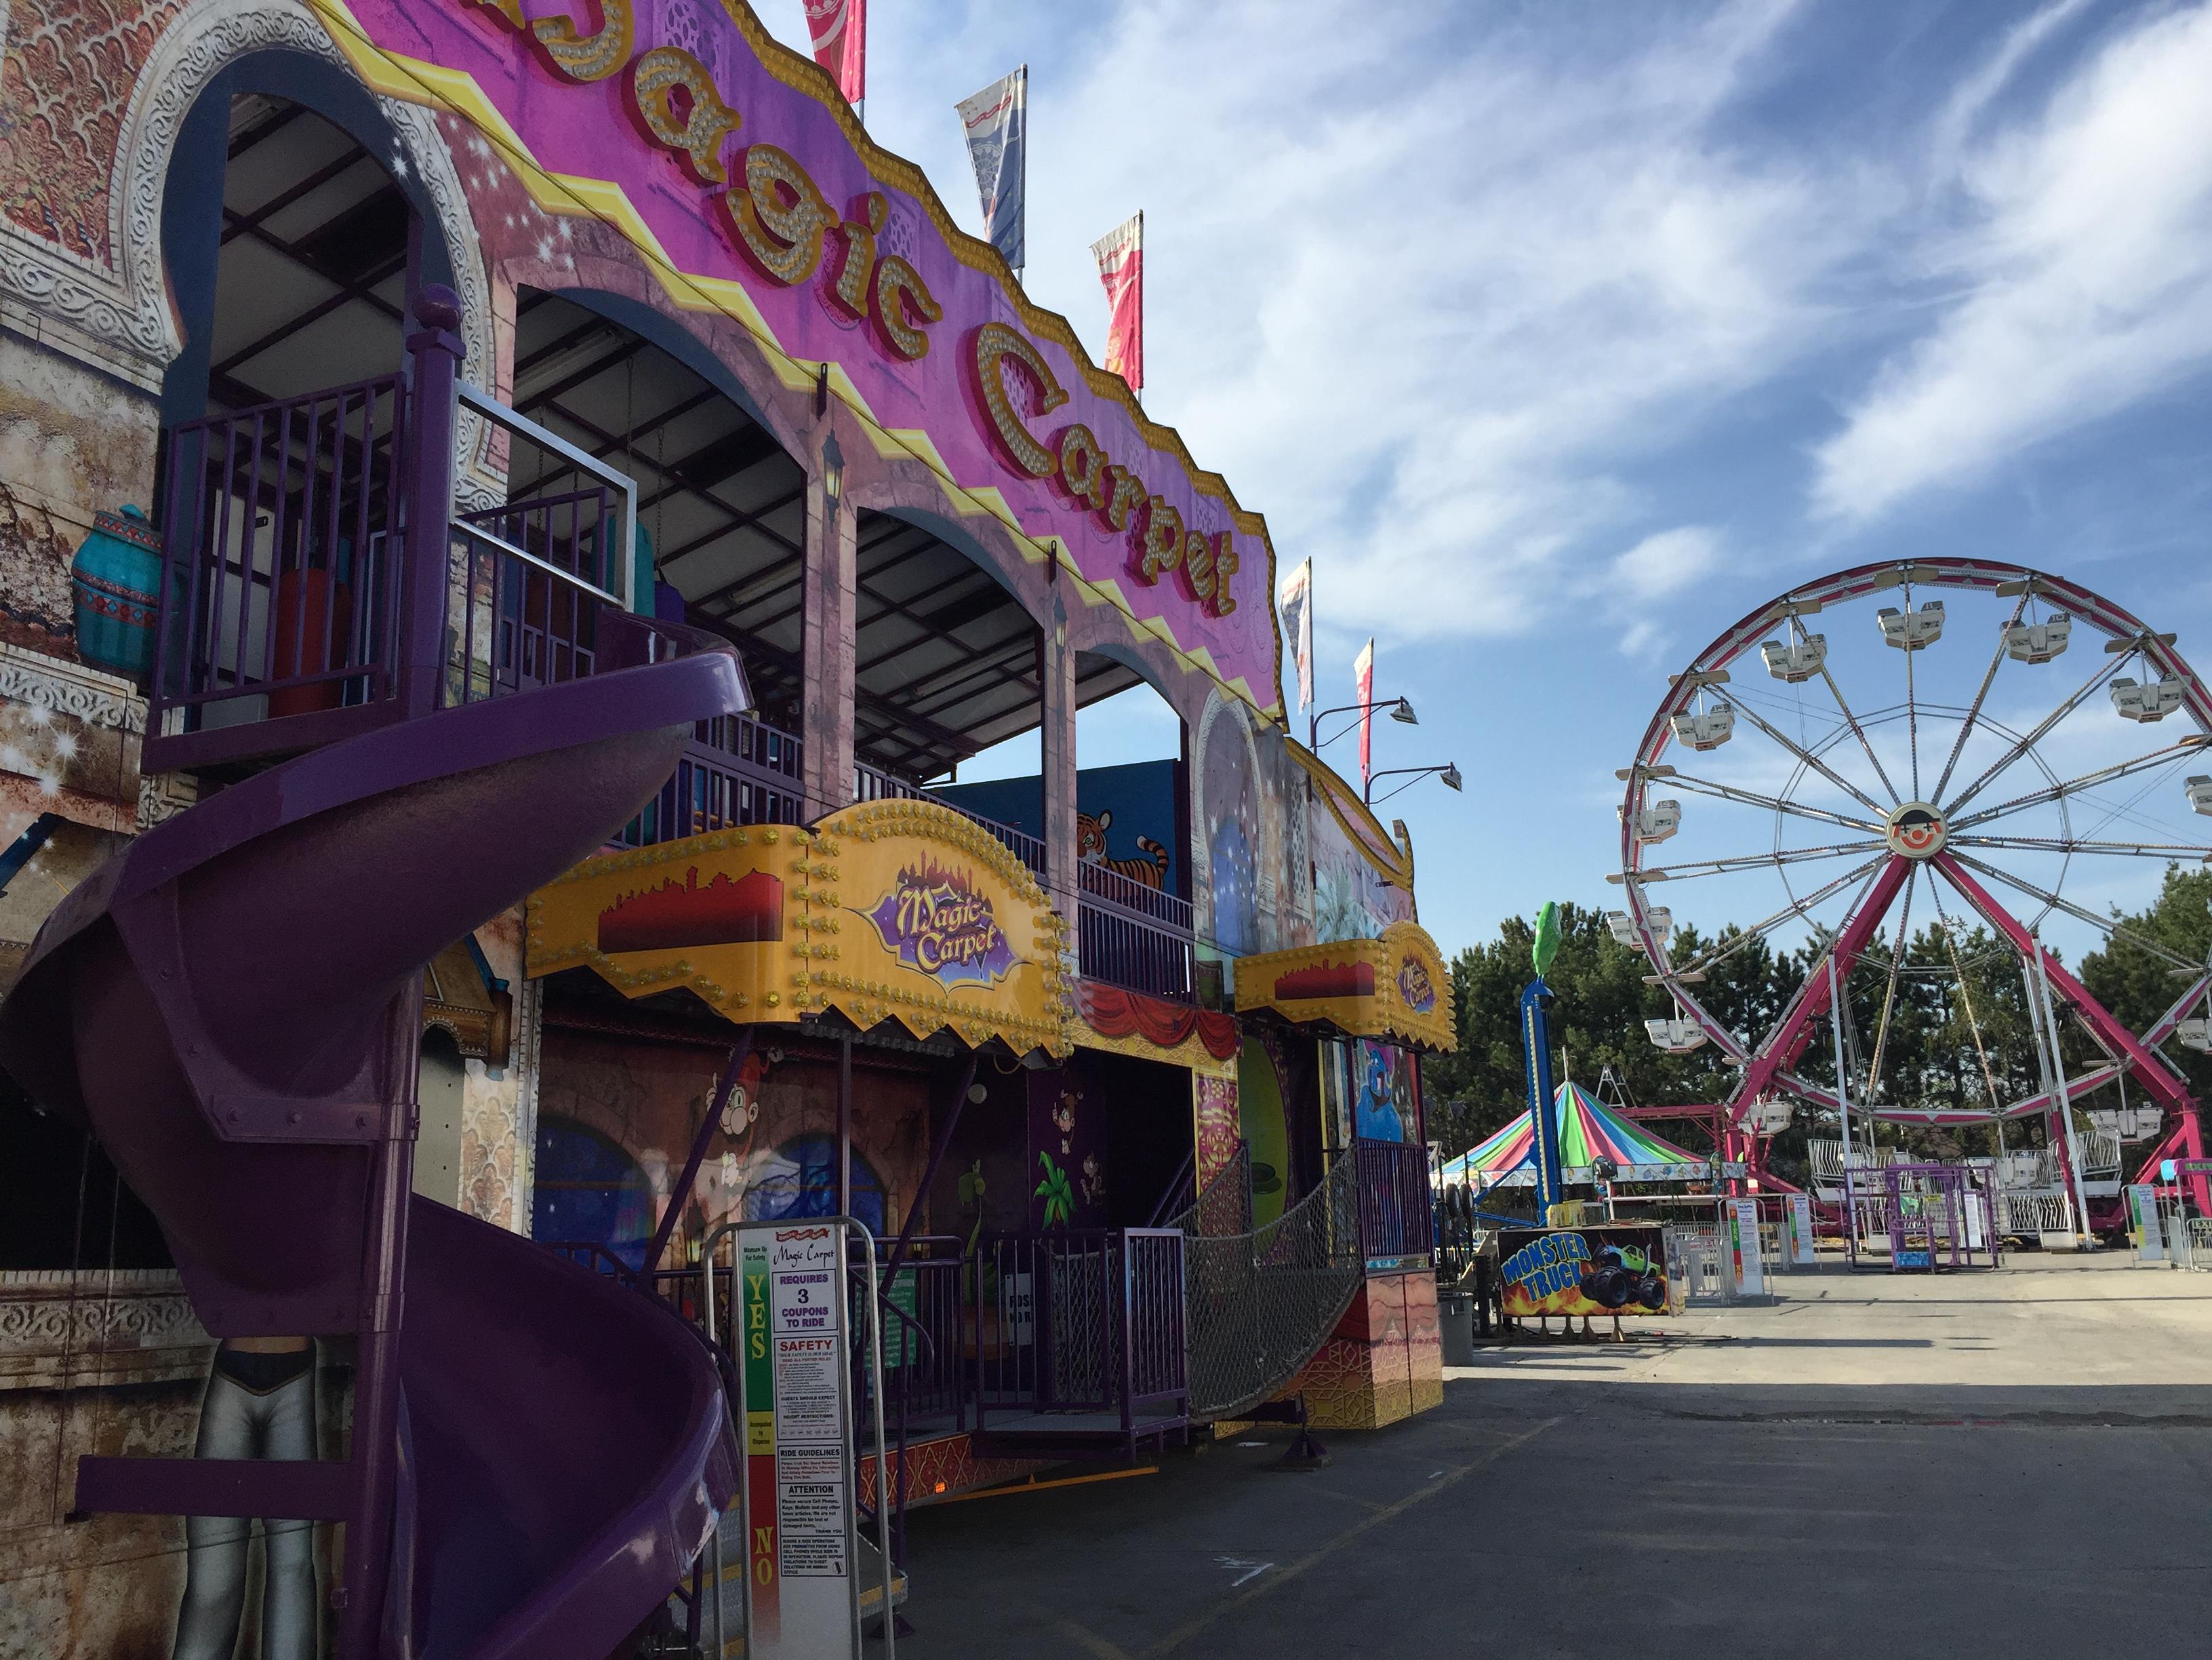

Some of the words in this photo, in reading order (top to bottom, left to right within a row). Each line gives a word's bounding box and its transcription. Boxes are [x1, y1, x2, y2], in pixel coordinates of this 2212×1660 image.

[971, 321, 1241, 617] Carpet
[896, 886, 981, 939] Magic
[917, 922, 996, 972] Carpet
[1409, 982, 1430, 1009] Carpet
[773, 1245, 803, 1267] Magic
[807, 1243, 834, 1269] Carpet
[1501, 1231, 1592, 1286] MONSTER
[780, 1273, 828, 1285] REQUIRES
[797, 1288, 809, 1304] 3
[1521, 1260, 1583, 1302] TRUCK
[746, 1273, 766, 1360] YES
[782, 1307, 829, 1317] COUPONS
[786, 1319, 800, 1328] TO
[802, 1318, 825, 1327] RIDE
[780, 1339, 833, 1351] SAFETY
[754, 1526, 774, 1585] NO
